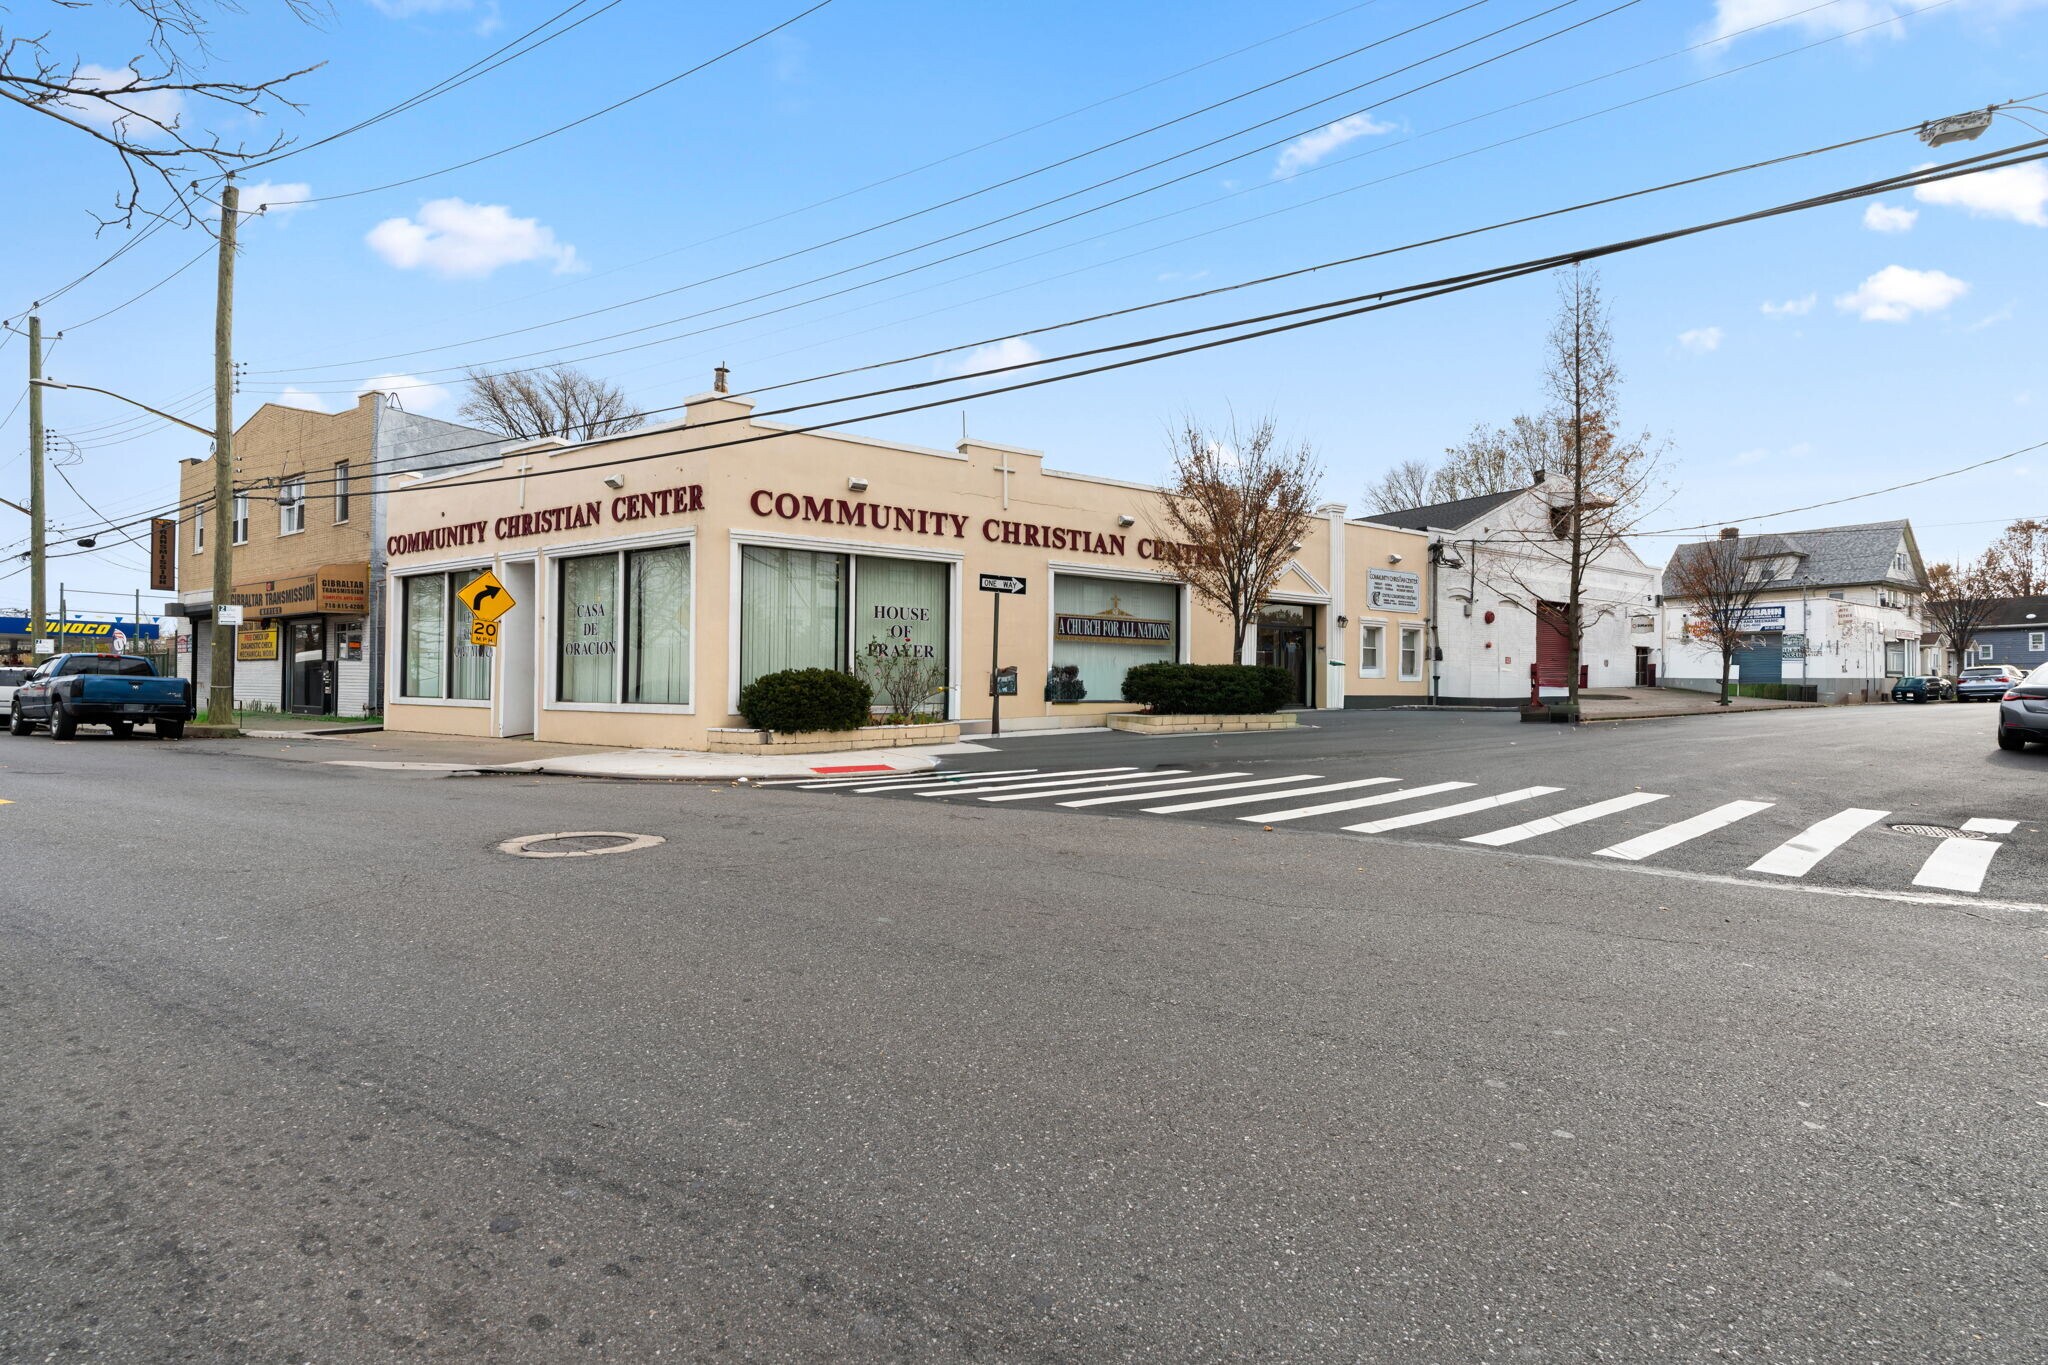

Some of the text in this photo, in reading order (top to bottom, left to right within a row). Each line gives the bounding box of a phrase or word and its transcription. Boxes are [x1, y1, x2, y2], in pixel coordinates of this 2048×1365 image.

[387, 484, 705, 556] COMMUNITY CHRISTIAN CENTER
[750, 490, 1223, 568] COMMUNITY CHRISTIAN CENTE
[322, 579, 364, 588] GIBRALTAR
[1003, 581, 1017, 589] WAY
[231, 583, 315, 608] GIBRALTAR TRANSMISSION
[577, 604, 605, 617] CASA
[874, 605, 929, 621] HOUSE
[474, 622, 496, 636] 20
[584, 622, 597, 636] DE
[891, 624, 912, 638] OF
[1059, 618, 1170, 639] A CHURCH FOR ALL NATIONS
[566, 641, 616, 656] ORACION
[868, 643, 934, 658] PRAYER
